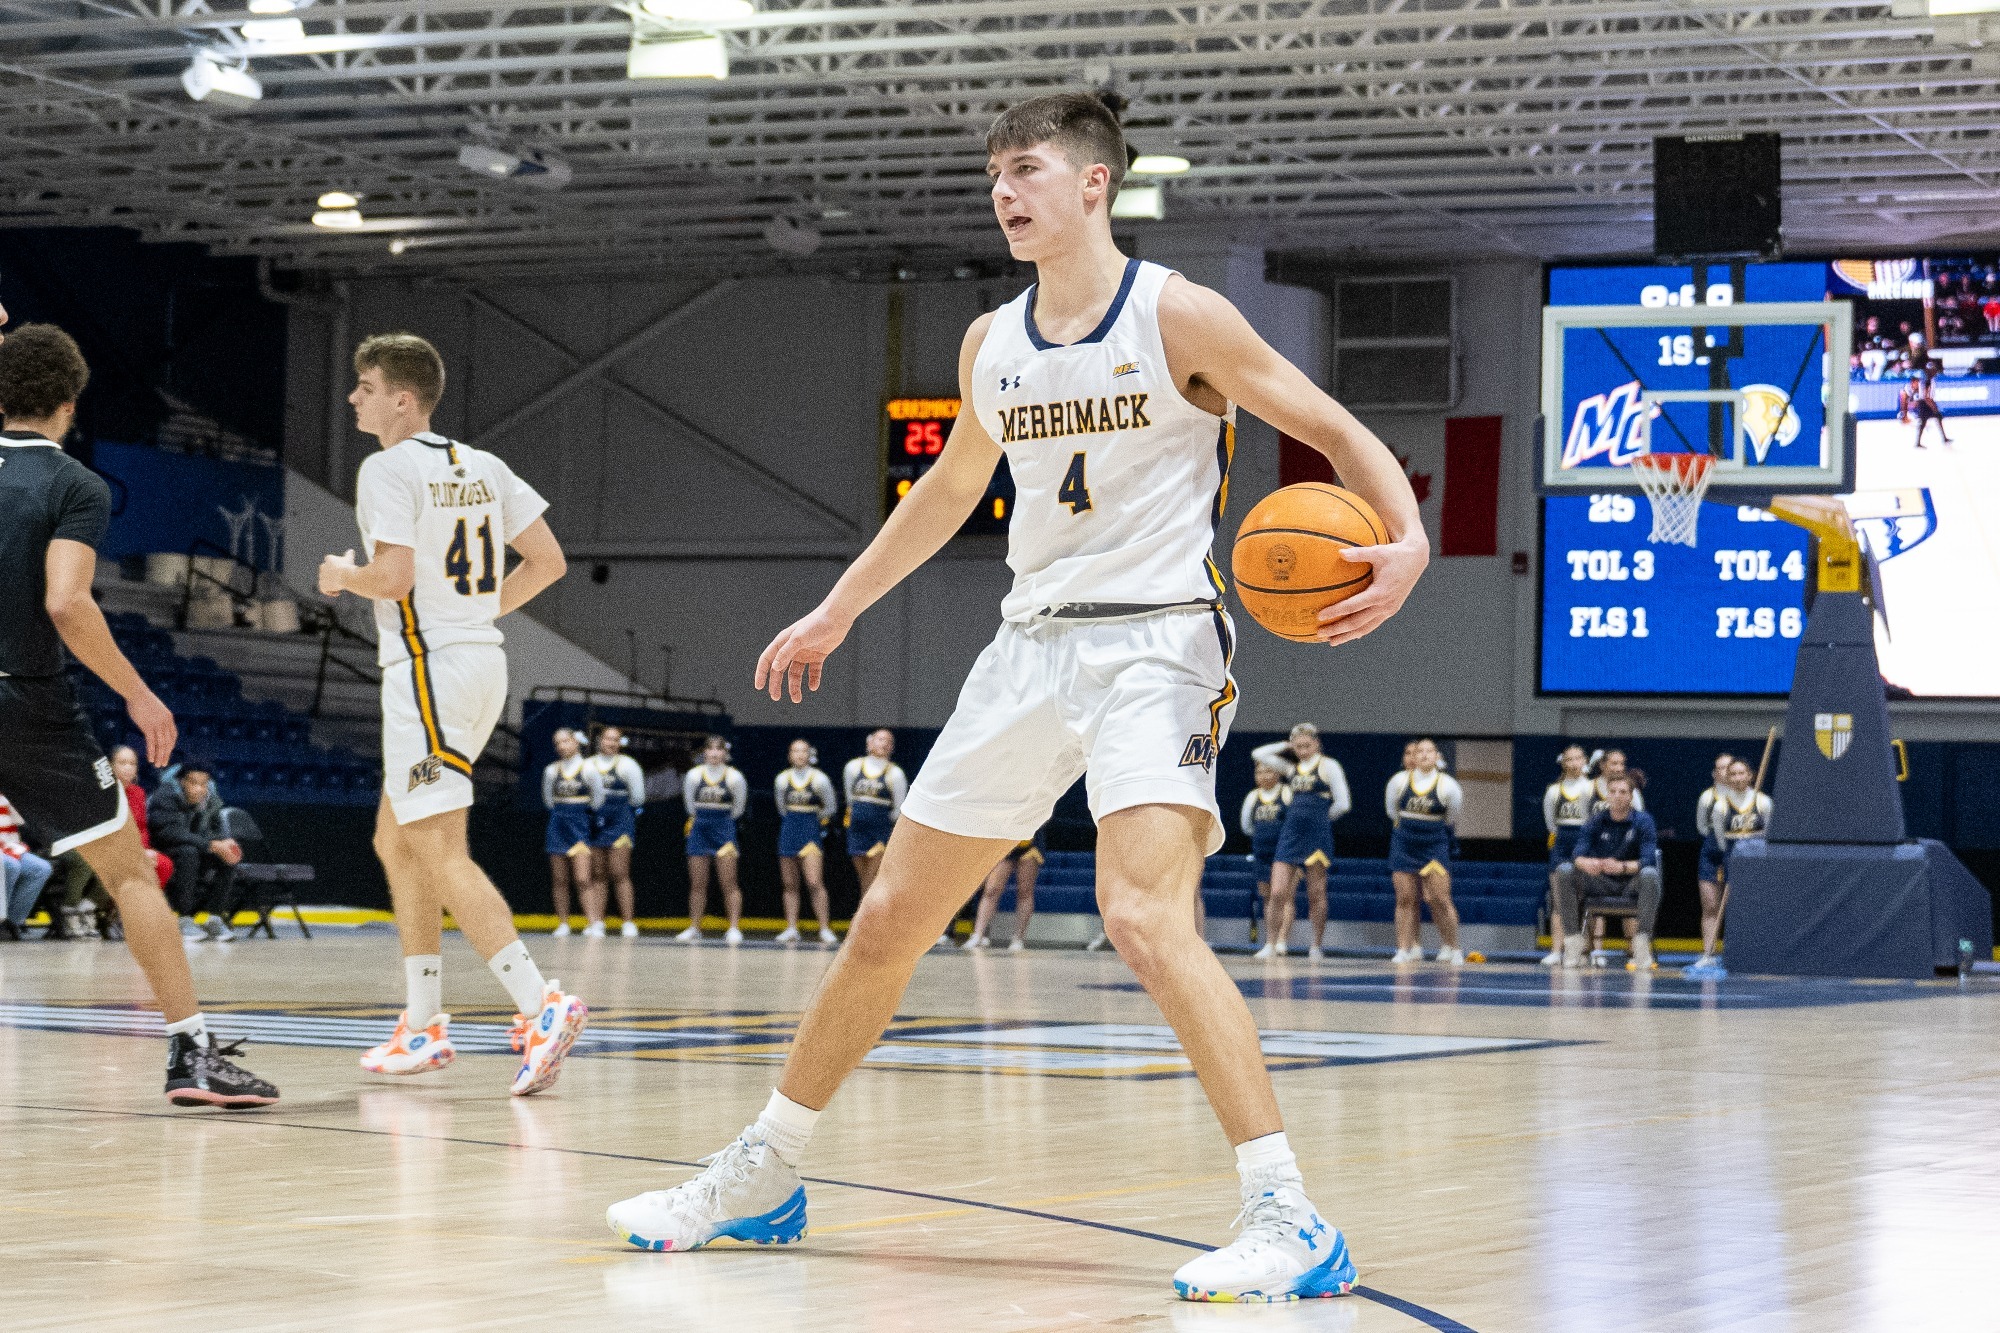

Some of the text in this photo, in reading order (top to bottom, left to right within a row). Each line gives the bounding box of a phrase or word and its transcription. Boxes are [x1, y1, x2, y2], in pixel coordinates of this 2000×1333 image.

[998, 393, 1151, 443] MERRIMACK
[904, 421, 944, 455] 25
[1058, 451, 1094, 516] 4
[1588, 494, 1636, 522] 25
[445, 514, 497, 596] 41
[1567, 550, 1655, 581] TOL 3
[1715, 550, 1805, 581] TOL 4
[1569, 607, 1649, 638] FLS 1
[1716, 607, 1803, 638] FLS 6
